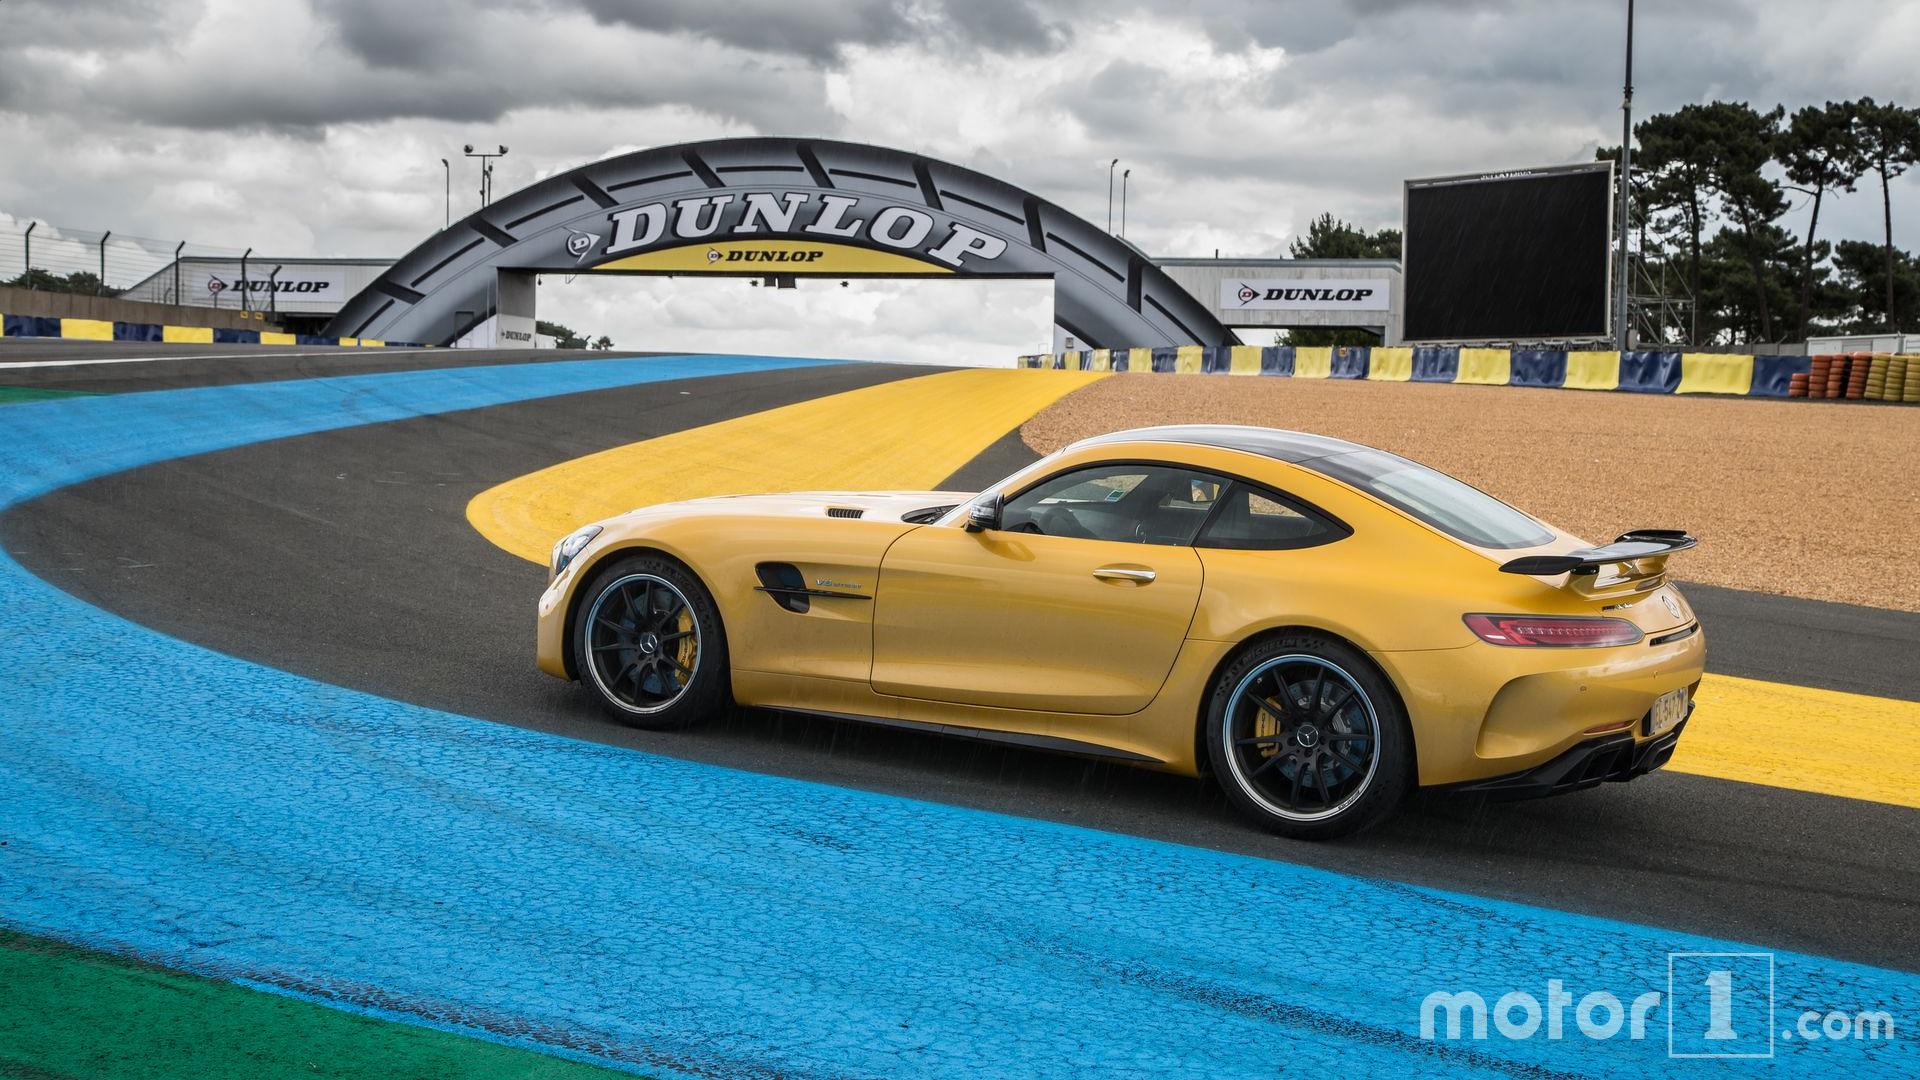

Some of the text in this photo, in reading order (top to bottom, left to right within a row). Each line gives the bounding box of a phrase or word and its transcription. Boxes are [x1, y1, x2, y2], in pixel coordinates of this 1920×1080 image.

[604, 191, 1008, 268] DUNLOP
[725, 250, 824, 262] DUNLOP
[230, 280, 330, 293] DUNLOP
[1263, 288, 1373, 301] DUNLOP
